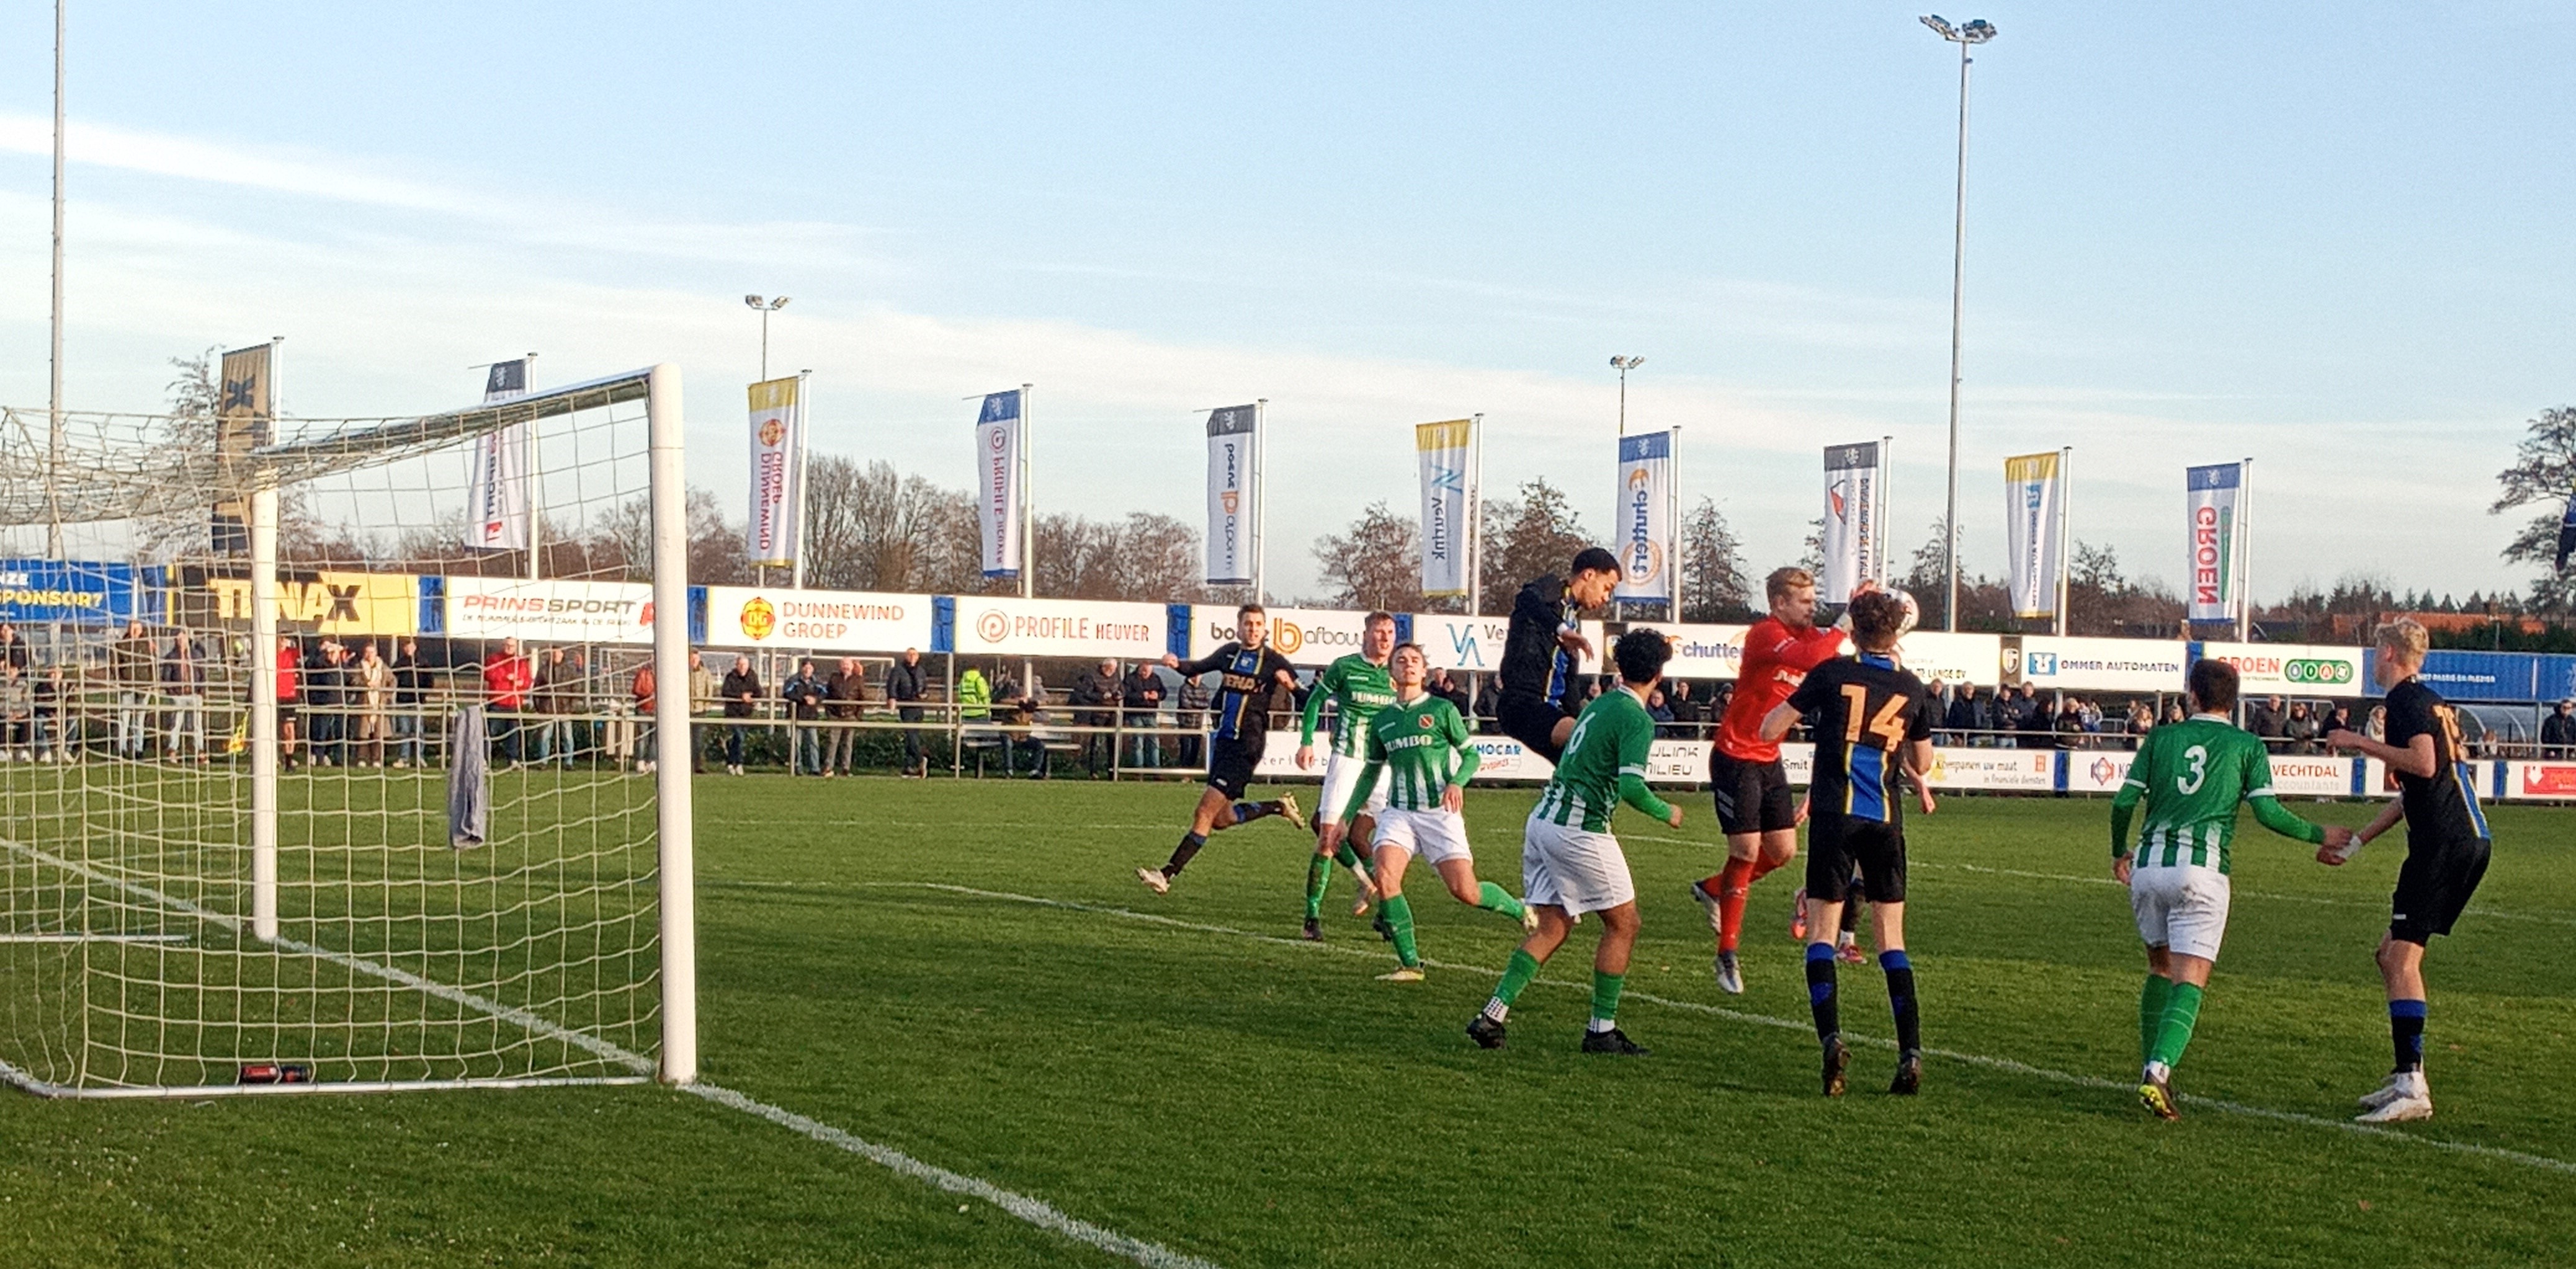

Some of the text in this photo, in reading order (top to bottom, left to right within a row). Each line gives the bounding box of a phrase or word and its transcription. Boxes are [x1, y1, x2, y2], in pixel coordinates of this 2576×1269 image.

[0, 590, 103, 608] PONSOR?
[783, 602, 904, 621] DUNNEWIND
[783, 622, 847, 638] GROEP
[1015, 616, 1149, 641] PROFILE HEUVER
[2061, 660, 2179, 672] OMMER AUTOMATEN
[1840, 683, 1909, 752] 14
[2177, 744, 2207, 795] 3
[2272, 764, 2339, 777] VECHTDAL
